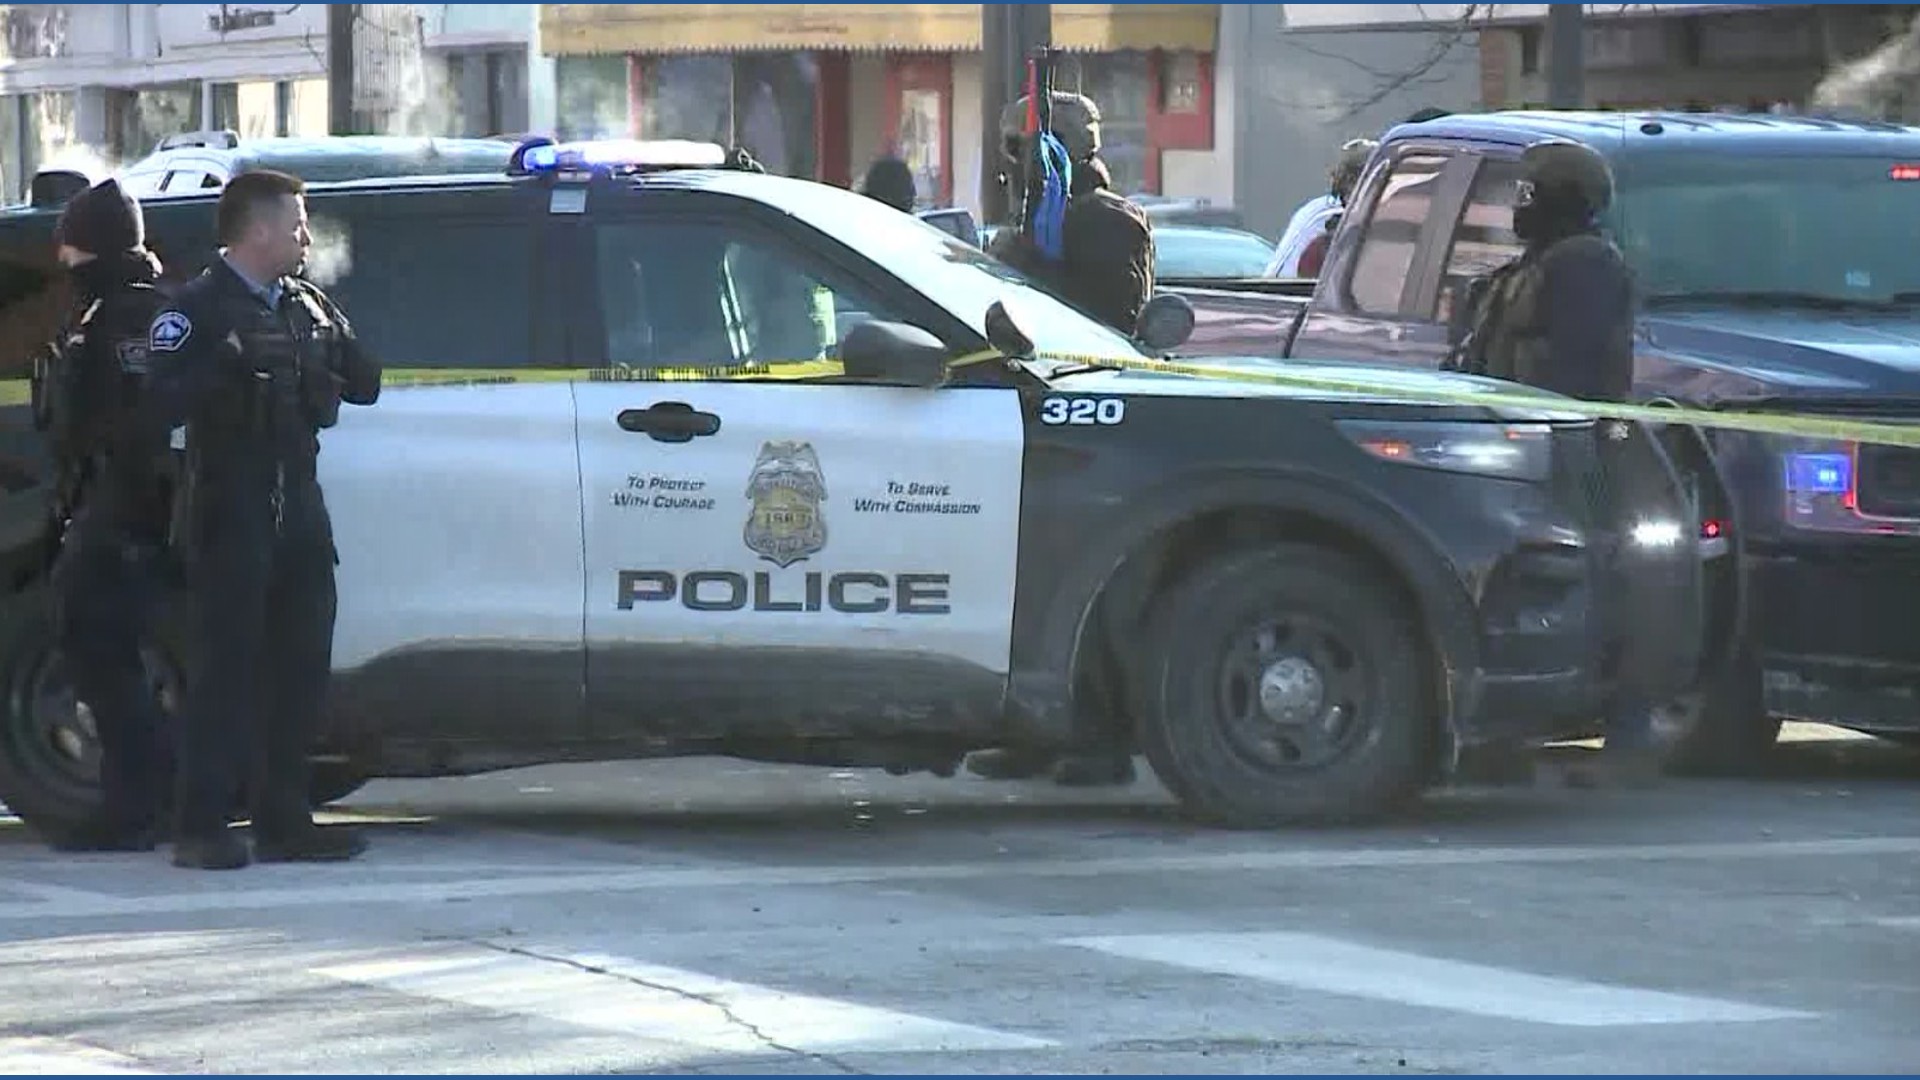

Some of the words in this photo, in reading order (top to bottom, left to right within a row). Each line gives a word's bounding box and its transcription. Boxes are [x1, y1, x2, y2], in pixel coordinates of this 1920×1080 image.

[1041, 397, 1125, 424] 320
[649, 478, 707, 491] PROTECT
[614, 493, 651, 506] WITH
[653, 495, 716, 510] COURAGE
[855, 499, 891, 512] WITH
[894, 500, 981, 514] COMPASSION
[616, 569, 951, 615] POLICE
